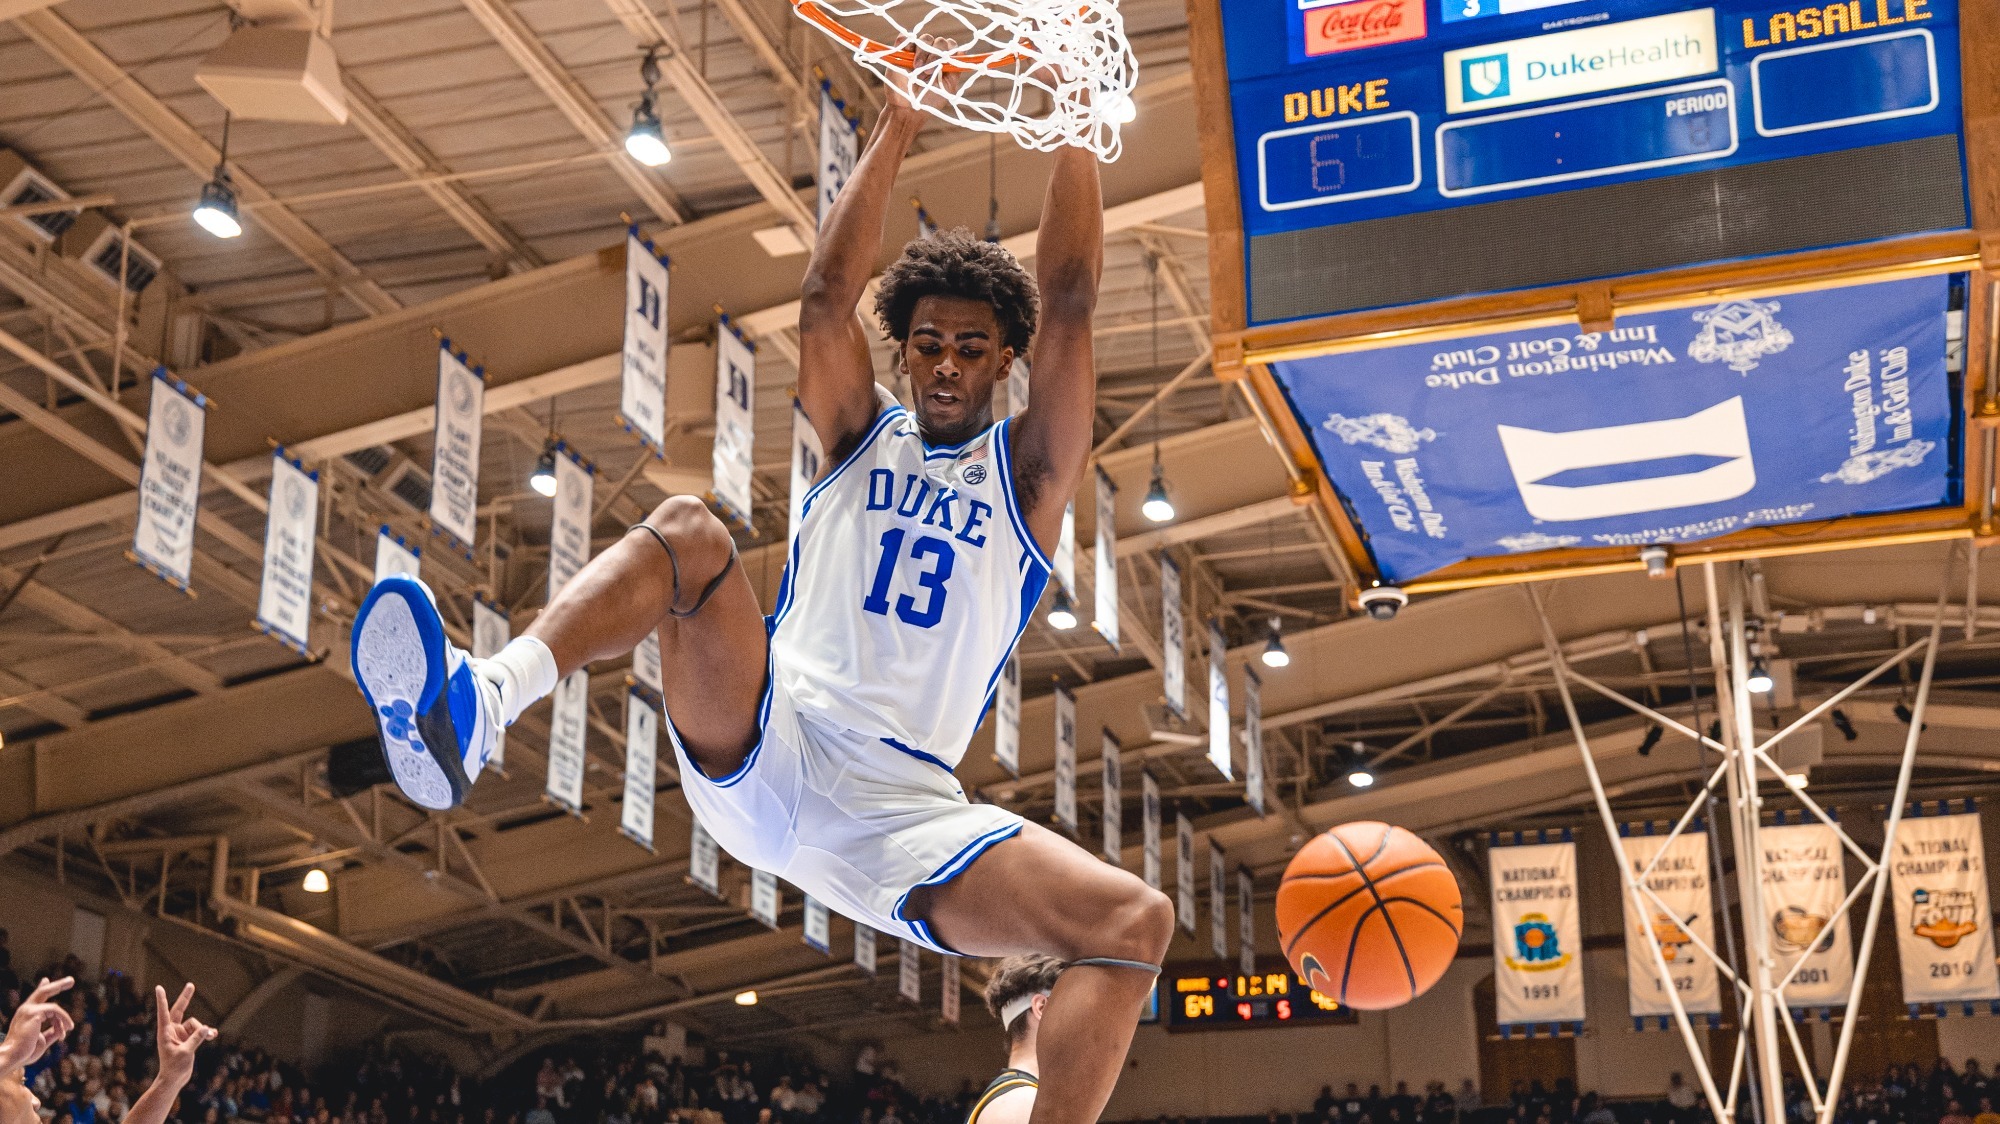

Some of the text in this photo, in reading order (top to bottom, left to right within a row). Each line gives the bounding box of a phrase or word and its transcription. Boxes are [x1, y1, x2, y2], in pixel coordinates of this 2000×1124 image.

[1743, 0, 1933, 48] LASALLE
[1284, 78, 1389, 123] DUKE
[1665, 92, 1728, 118] PERIOD
[1574, 331, 1602, 351] &
[1609, 325, 1659, 344] Inn
[1506, 337, 1571, 361] Golf
[1424, 346, 1677, 390] Washington Duke
[866, 468, 993, 549] DUKE
[863, 527, 956, 629] 13
[1901, 838, 1969, 856] NTIONAL
[1634, 857, 1695, 873] NTIONAL
[1896, 857, 1980, 876] CHAMPNS
[1522, 984, 1560, 1000] 1991
[1656, 976, 1694, 992] 192
[1185, 994, 1214, 1018] 64
